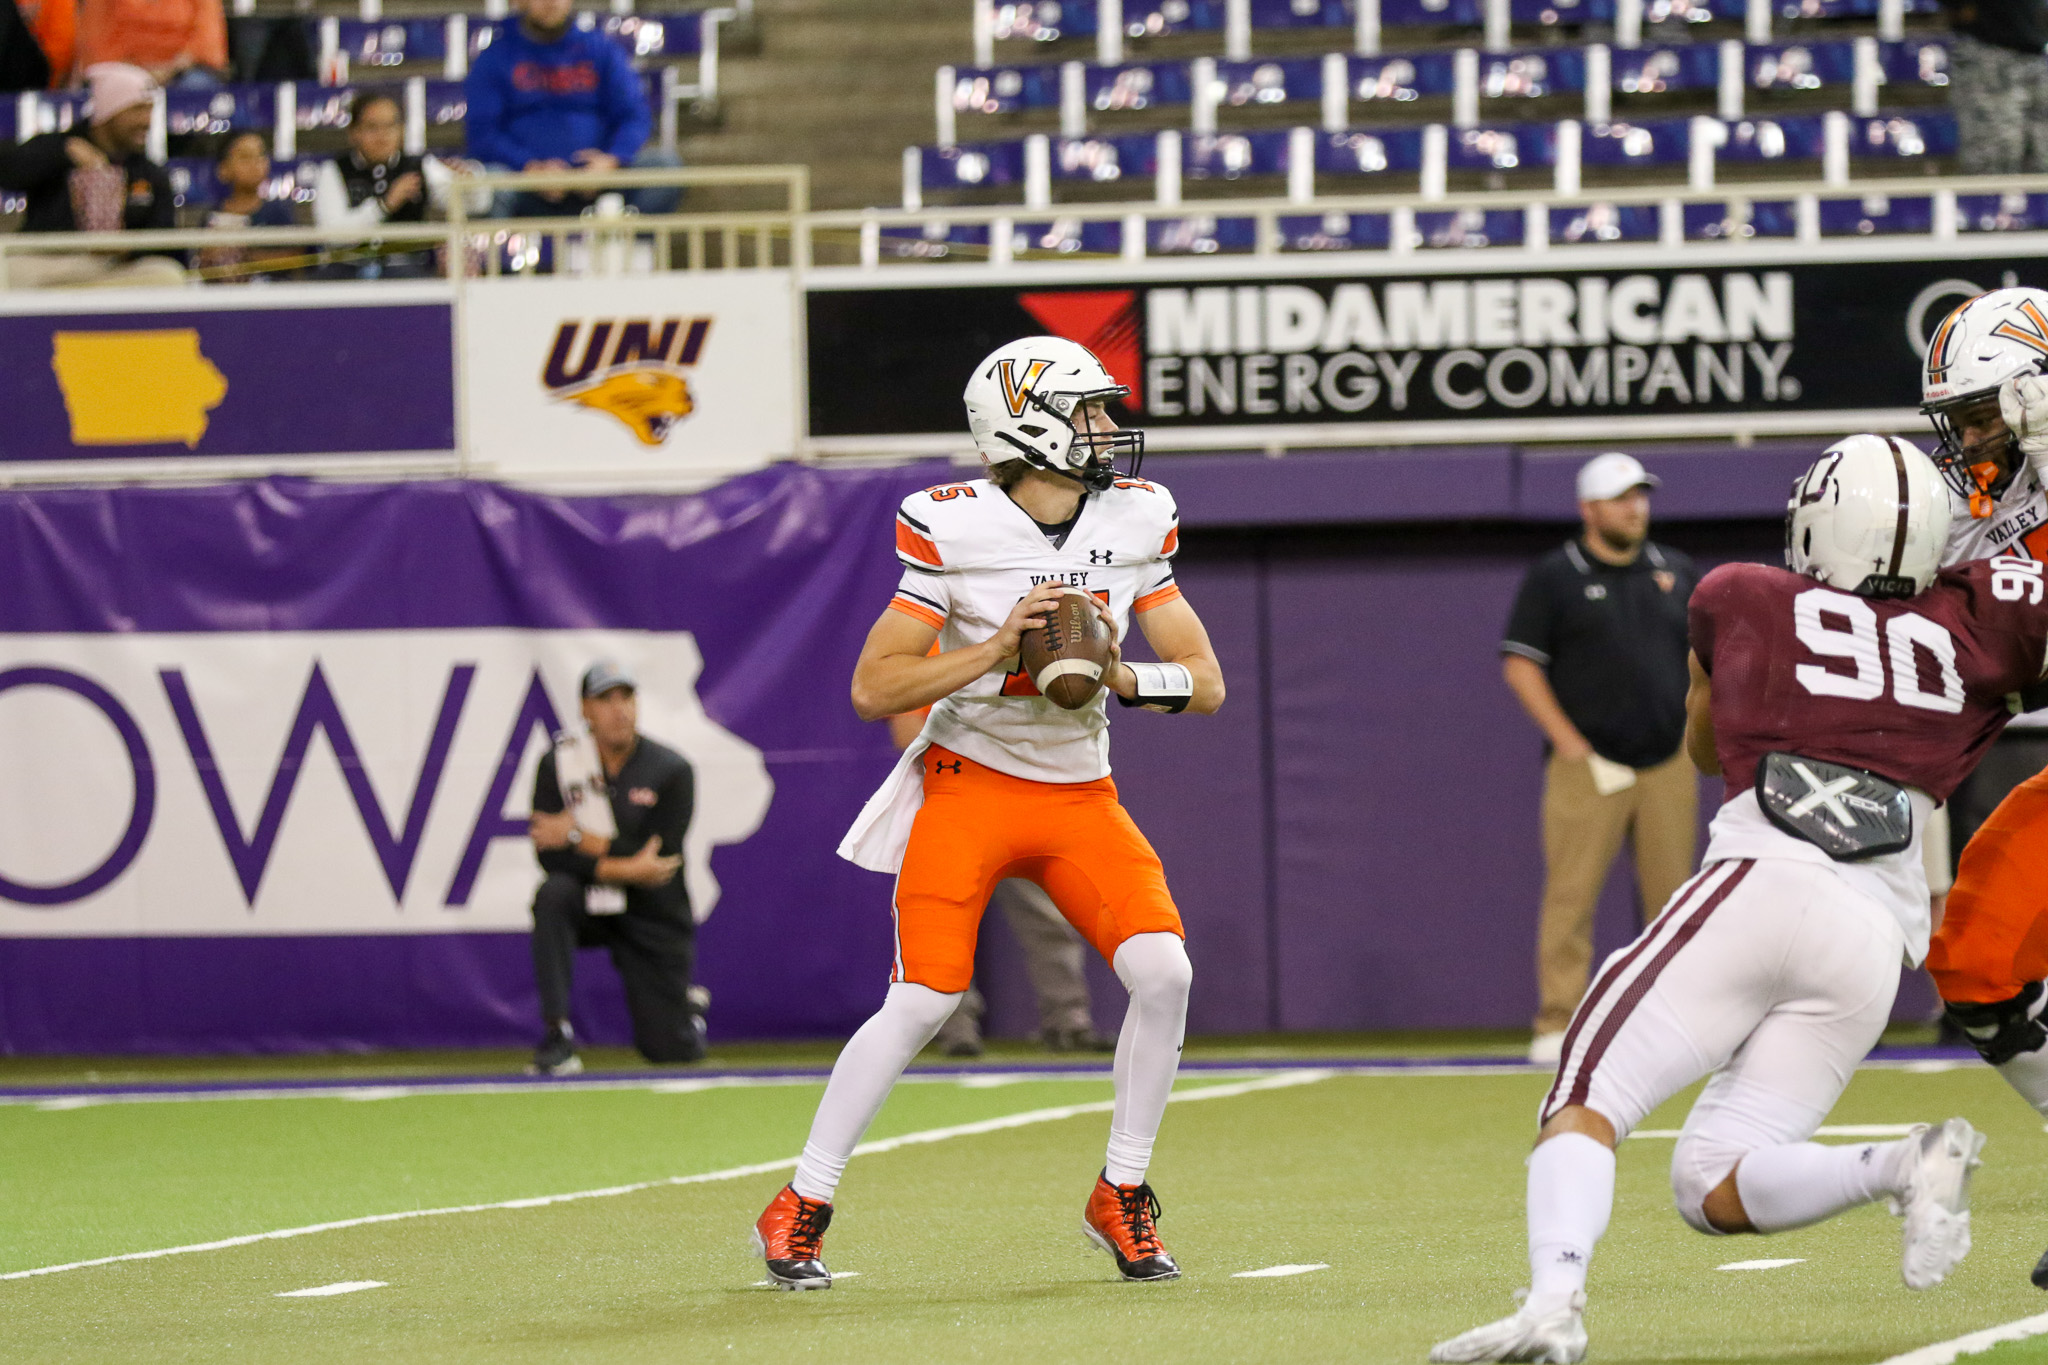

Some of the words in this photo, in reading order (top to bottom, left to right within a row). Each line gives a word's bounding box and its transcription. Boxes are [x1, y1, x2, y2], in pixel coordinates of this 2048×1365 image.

[1148, 272, 1793, 355] MIDAMERICAN
[542, 319, 712, 390] UNI
[1149, 350, 1421, 416] ENERGY
[998, 358, 1055, 418] V
[1985, 506, 2039, 545] VALLEY
[1990, 556, 2043, 605] 90
[1069, 603, 1082, 644] Wilson
[1794, 588, 1966, 714] 90
